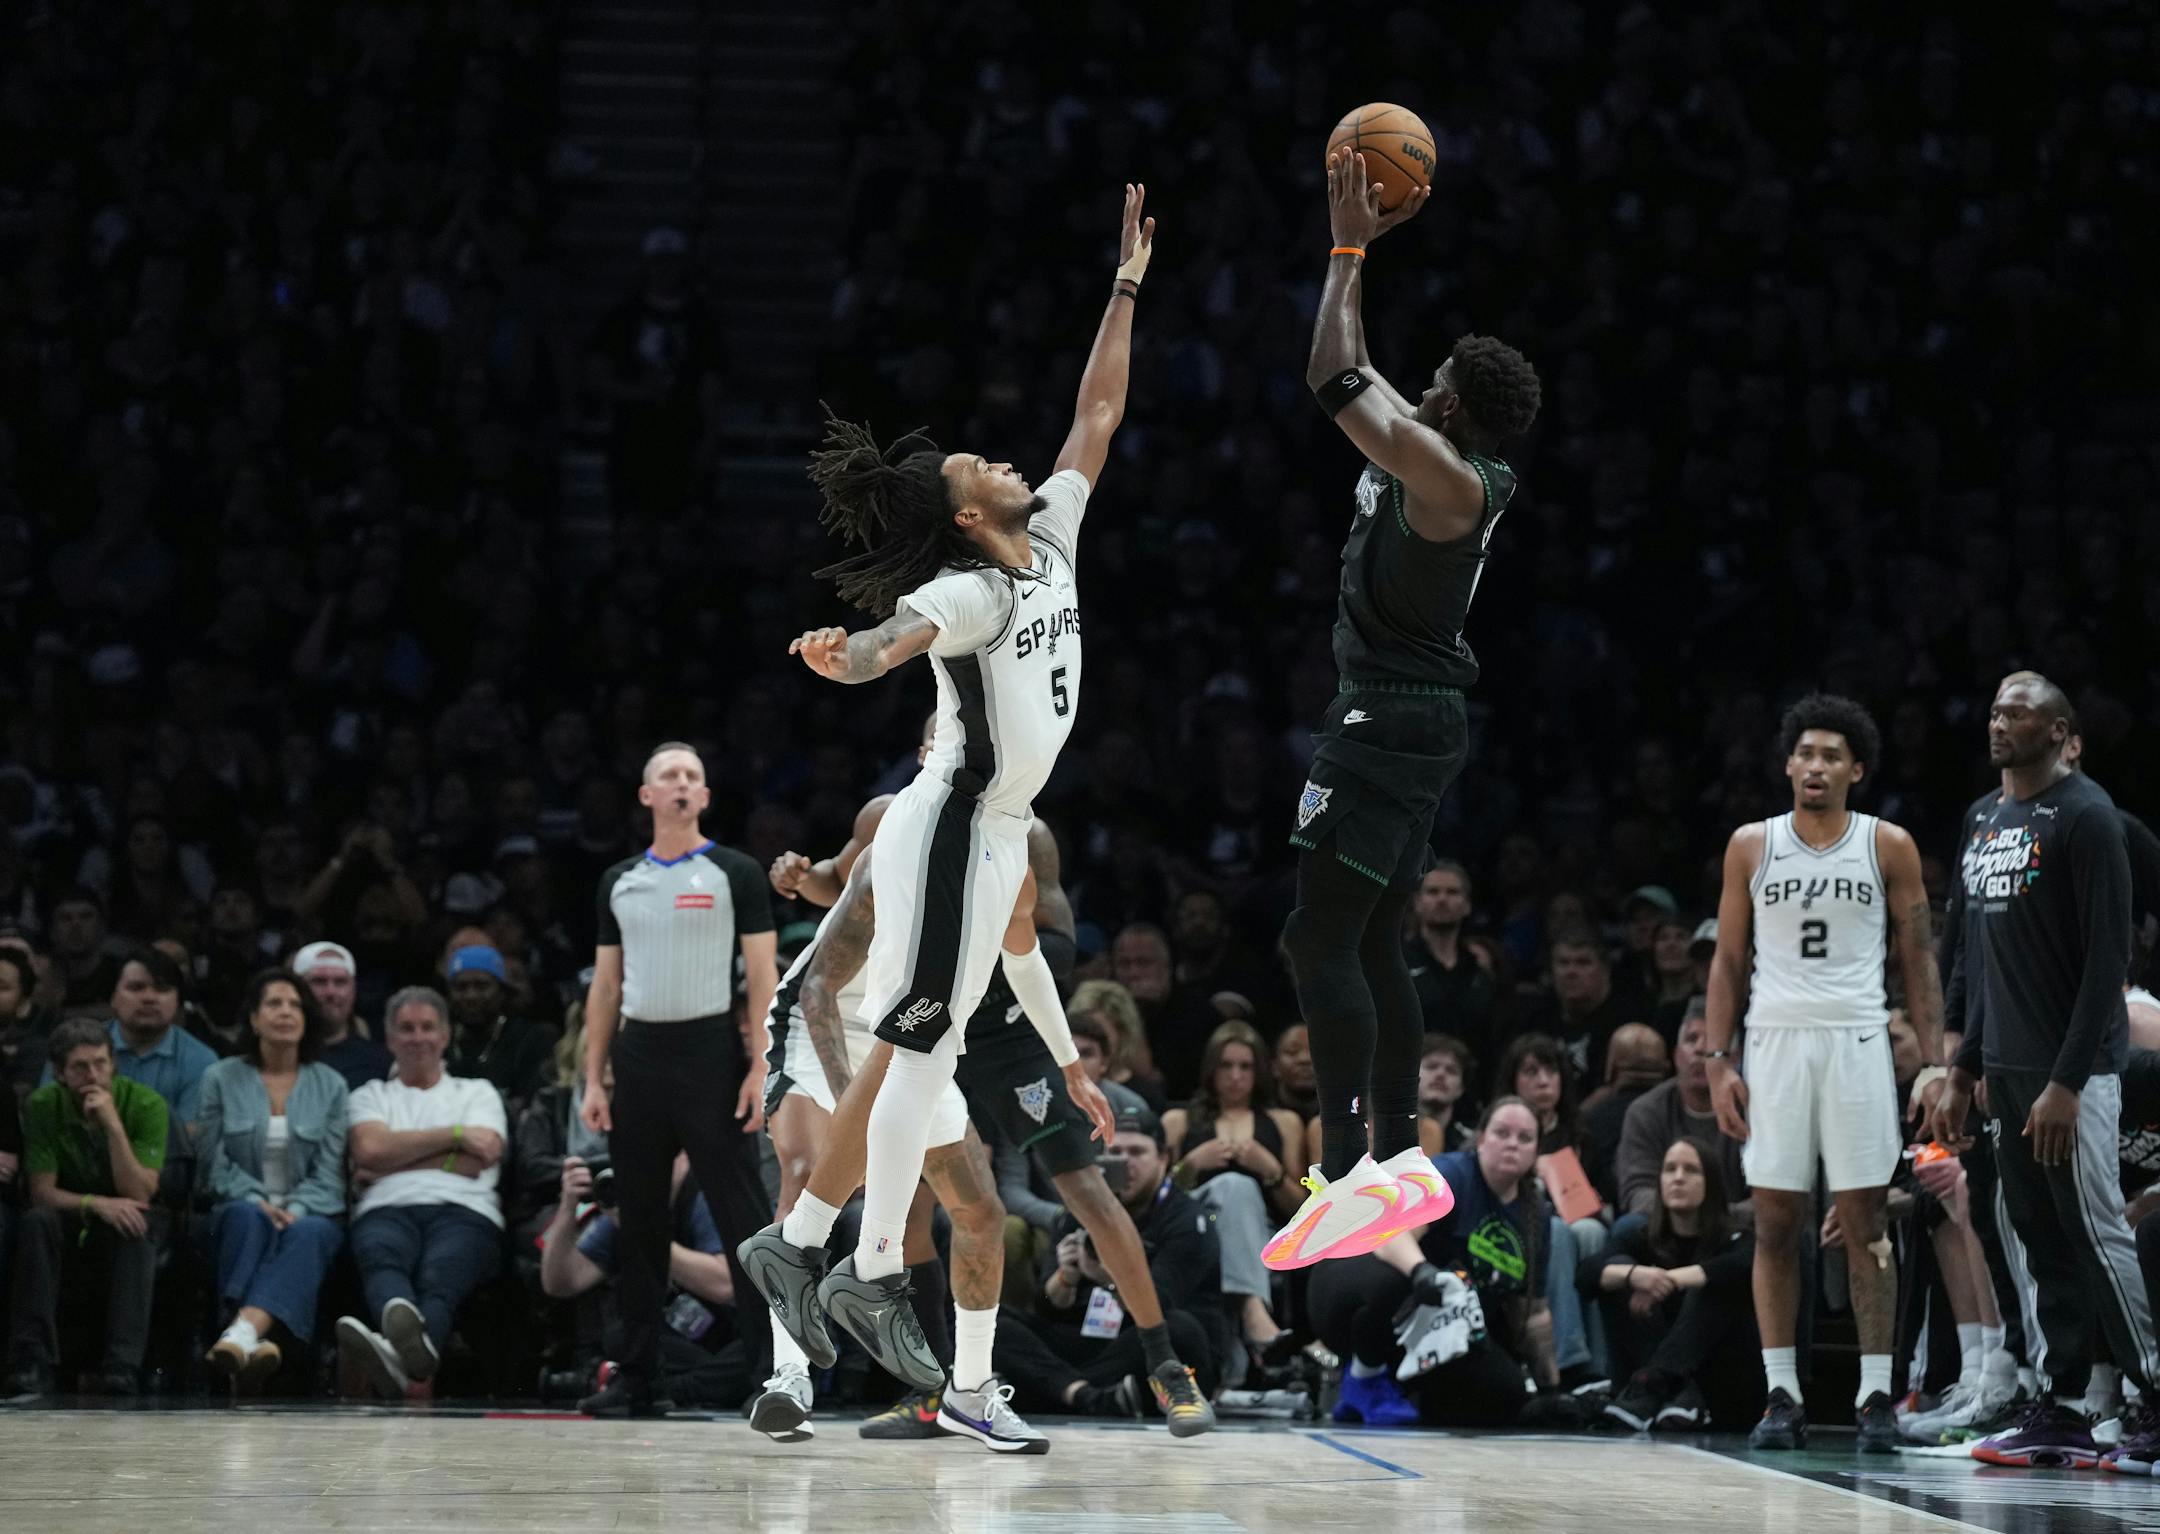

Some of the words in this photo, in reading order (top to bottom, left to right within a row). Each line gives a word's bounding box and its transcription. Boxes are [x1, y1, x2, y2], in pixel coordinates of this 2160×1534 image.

[1051, 666, 1069, 717] 5
[1996, 827, 2024, 850] GO
[1765, 877, 1873, 910] SPURS
[1985, 875, 2011, 898] GO
[1801, 919, 1828, 959] 2
